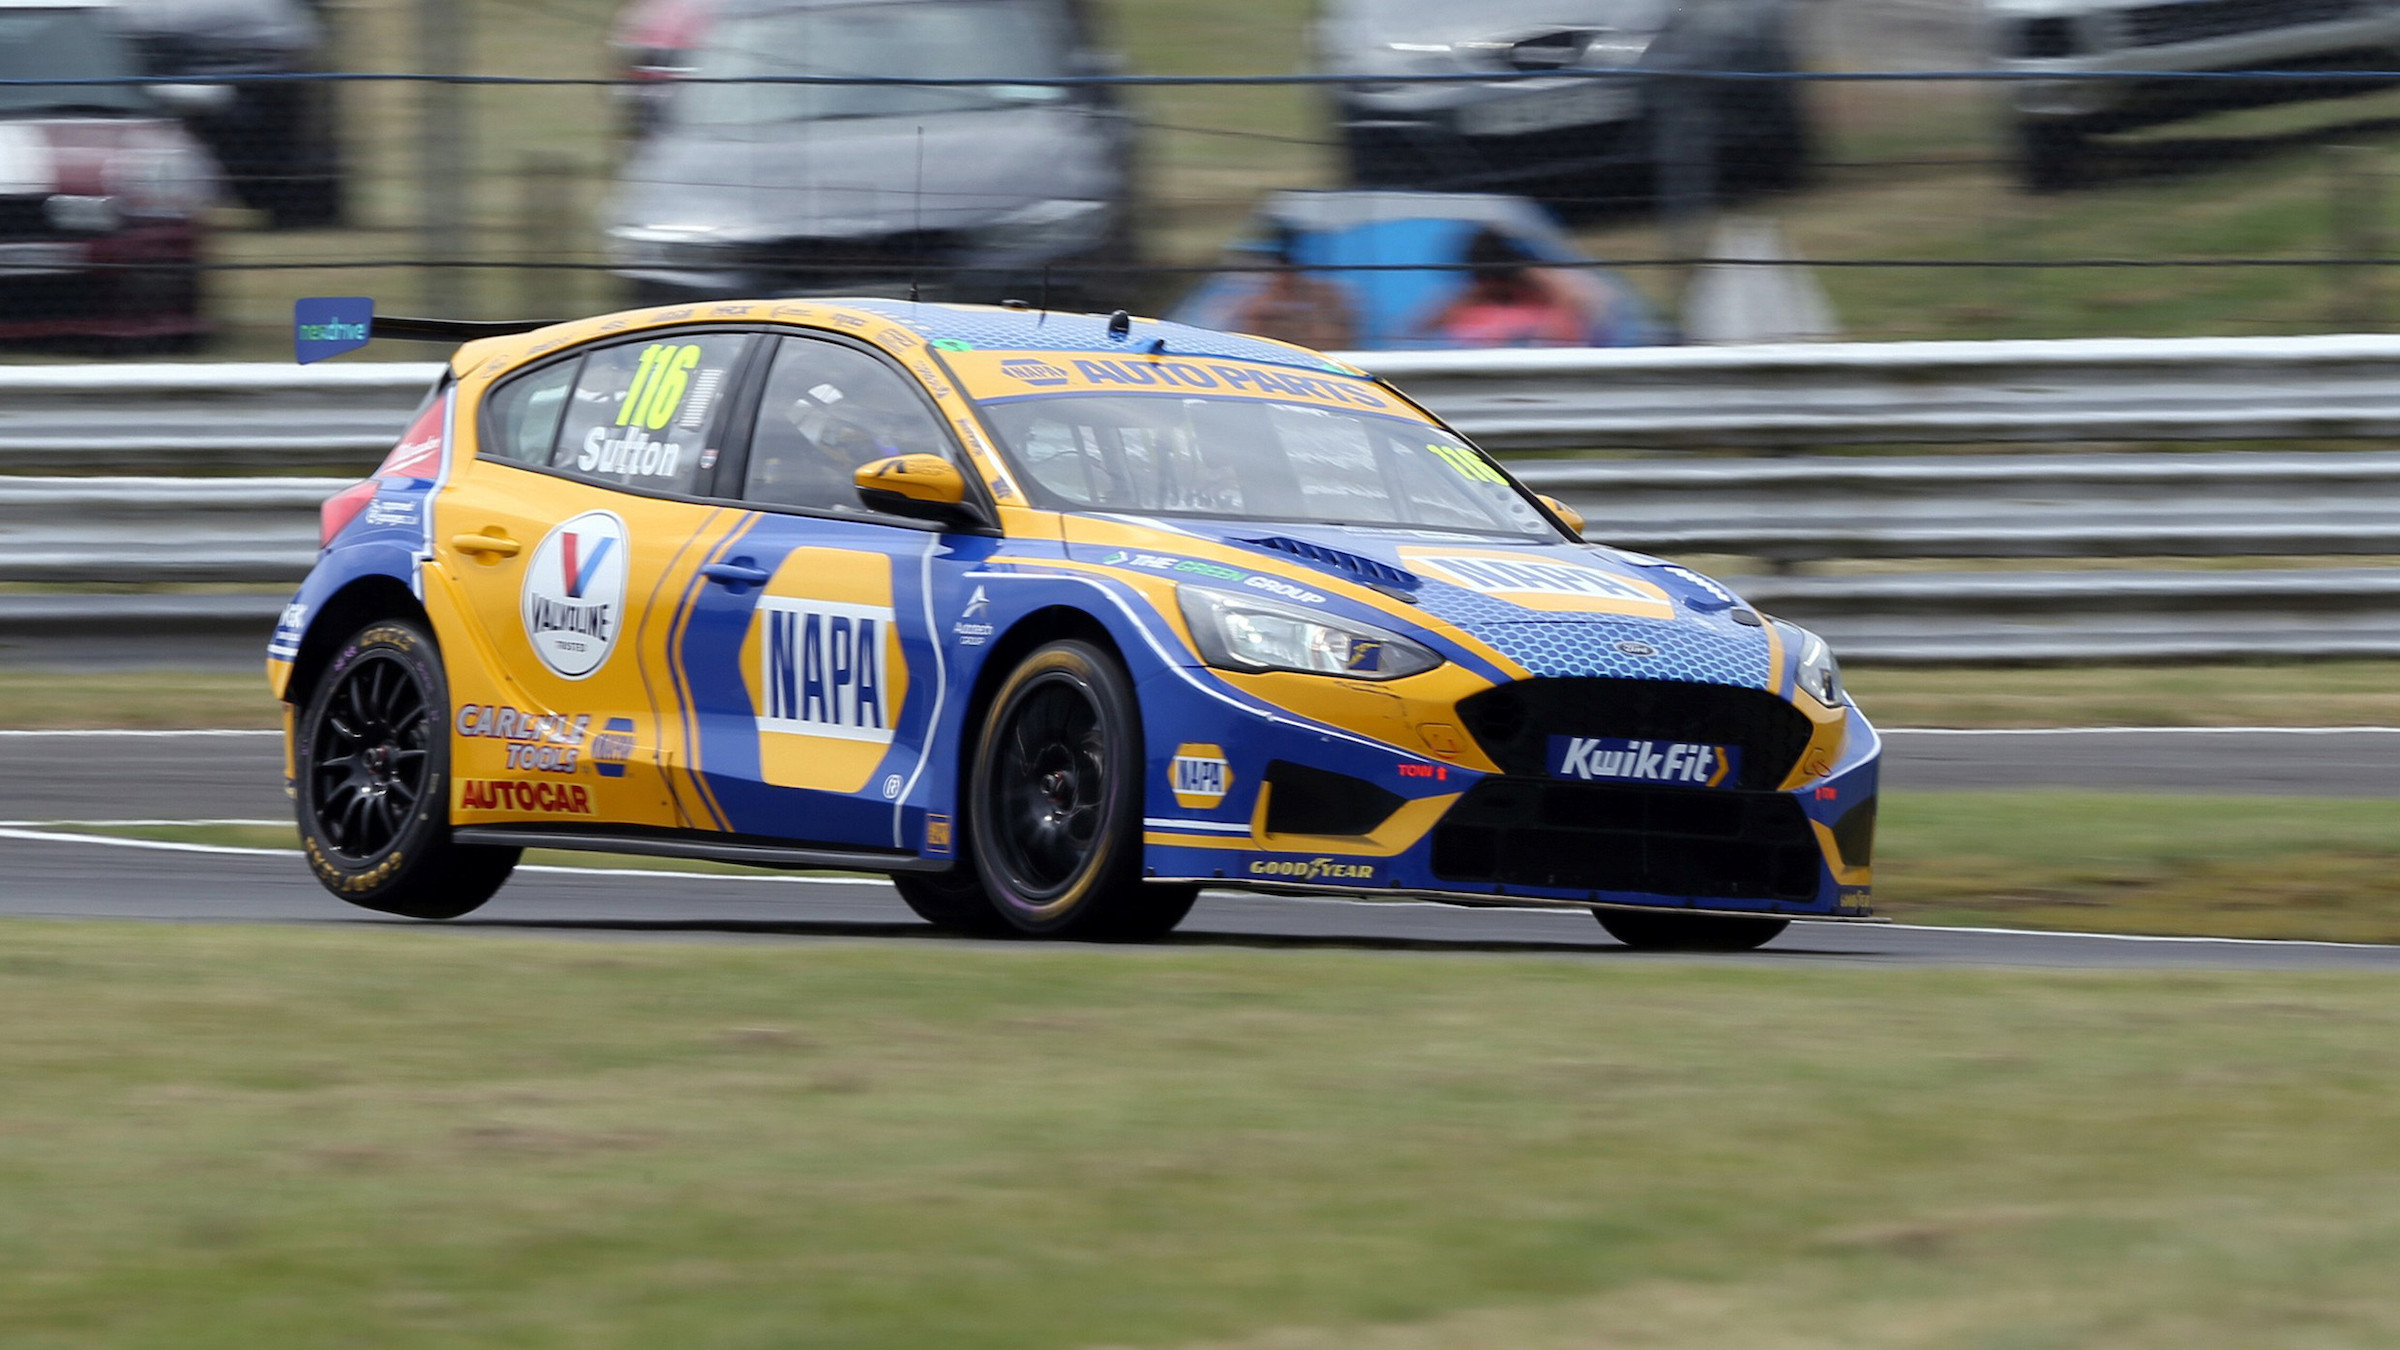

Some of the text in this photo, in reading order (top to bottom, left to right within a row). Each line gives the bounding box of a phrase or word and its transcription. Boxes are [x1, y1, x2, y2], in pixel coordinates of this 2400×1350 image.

[615, 344, 702, 430] 116
[1006, 364, 1064, 380] NAPA
[1071, 359, 1388, 408] AUTO PARTS
[577, 426, 681, 477] Sutton
[1426, 444, 1510, 486] 116
[1129, 554, 1328, 604] THE GREEN GROUP
[1424, 557, 1656, 600] NAPA
[769, 609, 884, 729] NAPA
[455, 703, 593, 746] CARLYLE
[506, 742, 580, 774] TOOLS
[1175, 758, 1226, 793] NAPA
[1397, 763, 1435, 778] TOW
[461, 779, 592, 815] AUTOCAR
[1249, 857, 1376, 881] GOODYEAR
